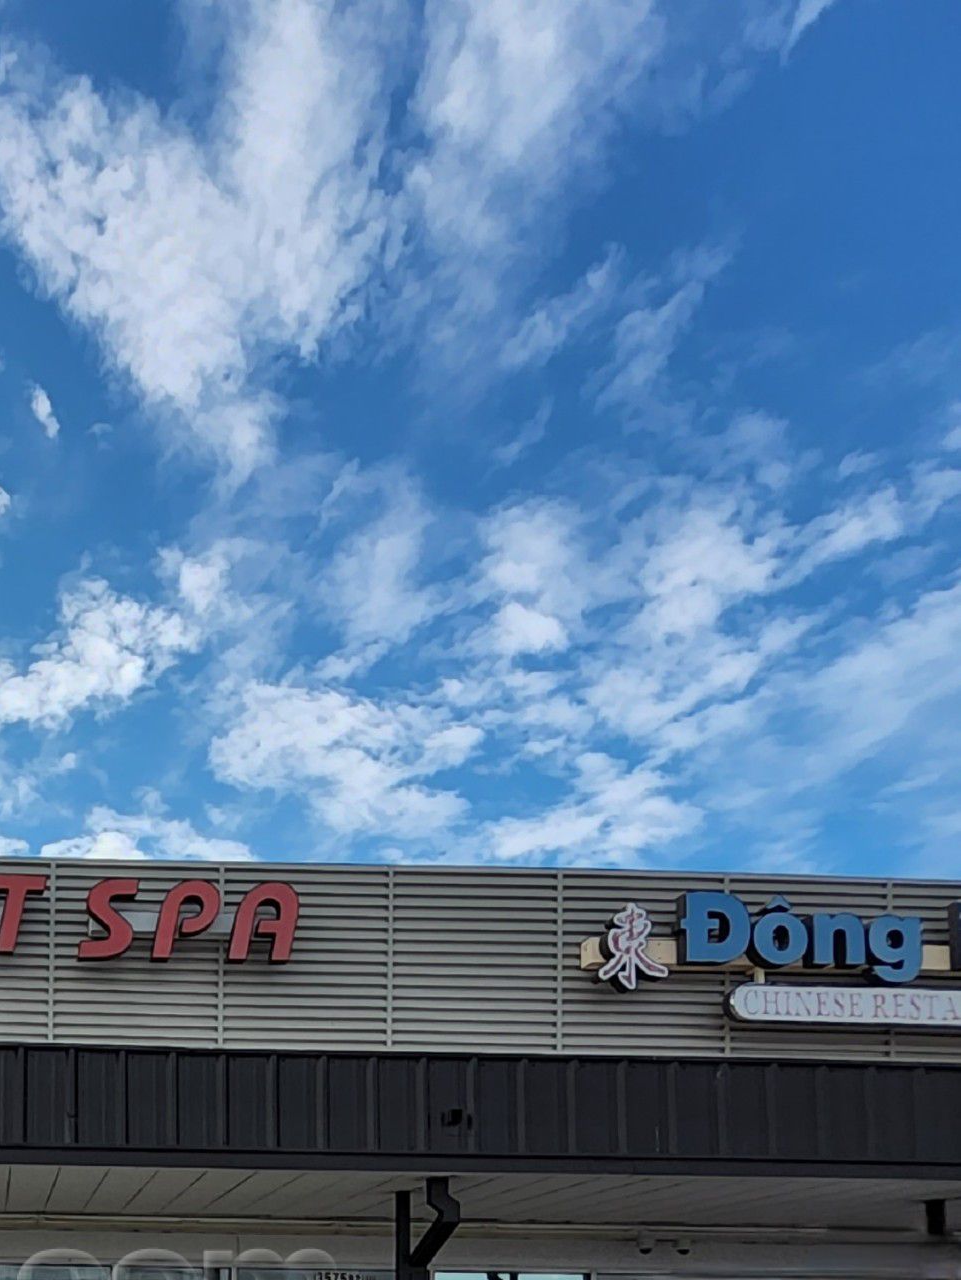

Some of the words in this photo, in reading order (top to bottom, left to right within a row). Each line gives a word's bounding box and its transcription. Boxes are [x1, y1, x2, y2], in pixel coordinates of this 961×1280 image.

[76, 877, 301, 965] SPA
[680, 890, 923, 984] Đông
[742, 987, 865, 1019] CHINESE
